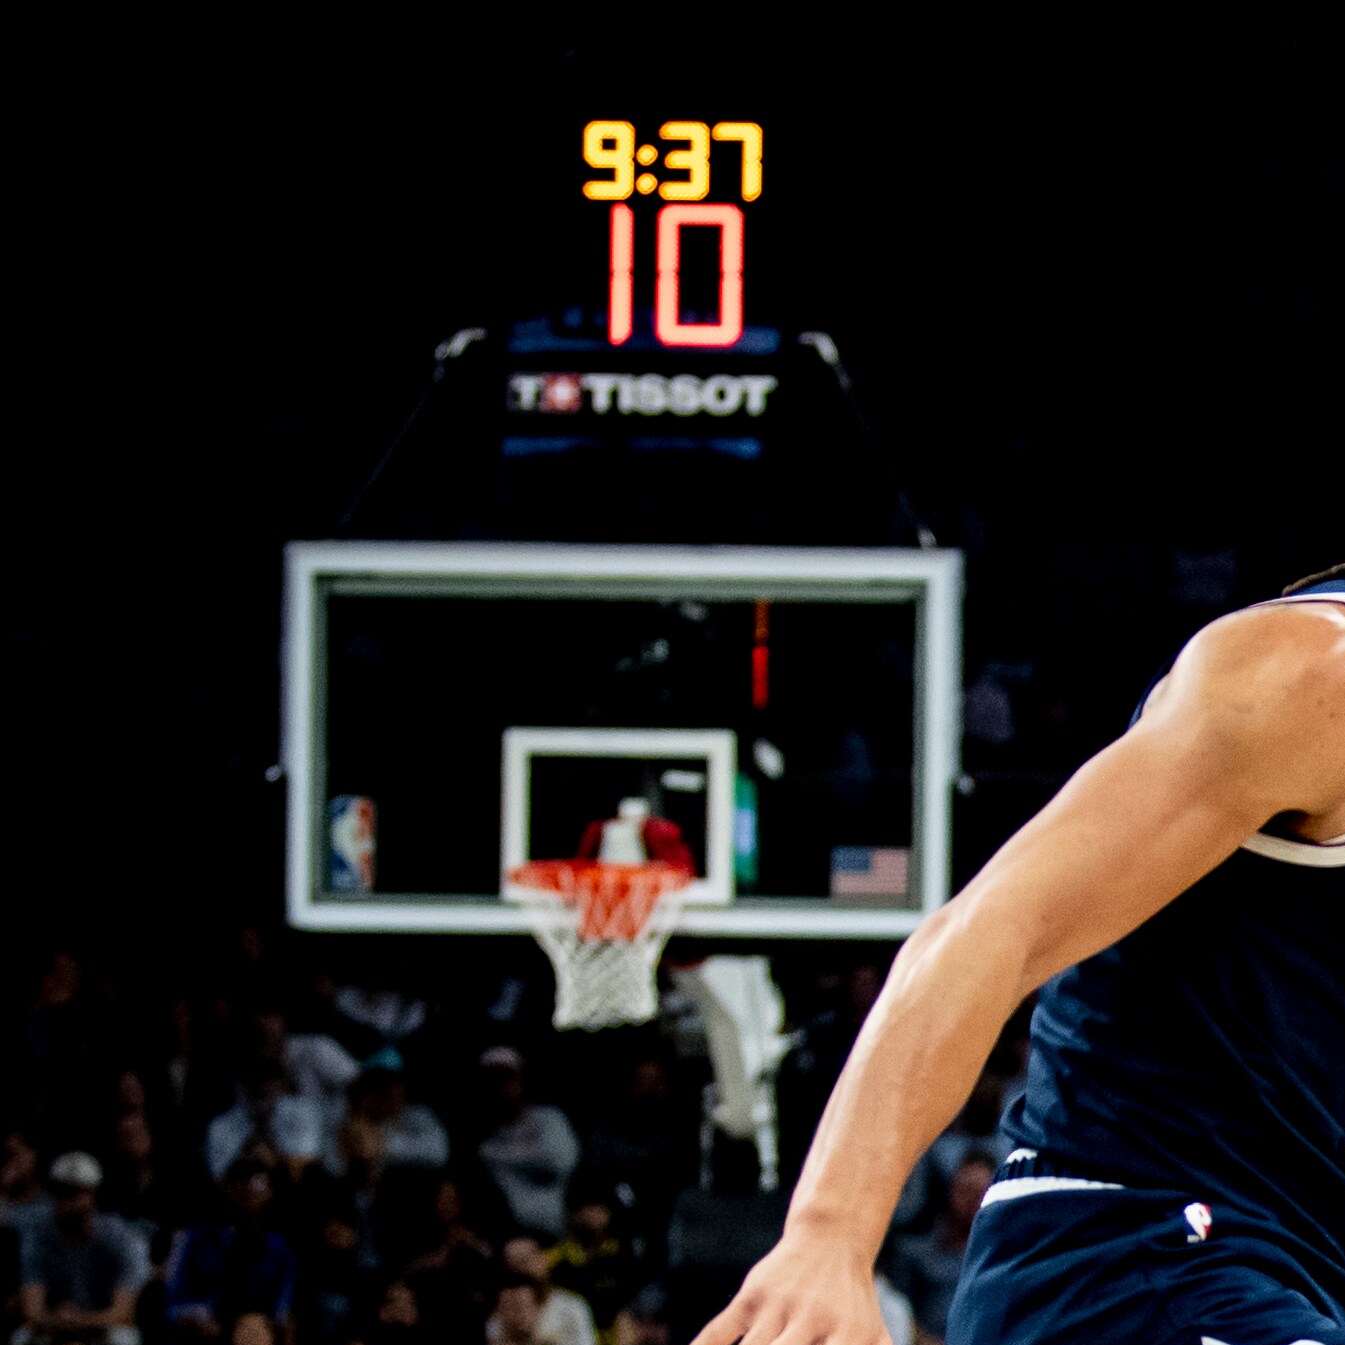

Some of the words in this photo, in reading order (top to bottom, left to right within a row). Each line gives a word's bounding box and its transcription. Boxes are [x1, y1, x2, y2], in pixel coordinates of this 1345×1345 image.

[582, 120, 764, 202] 9:37
[606, 202, 744, 347] 10
[582, 374, 779, 417] TISSOT
